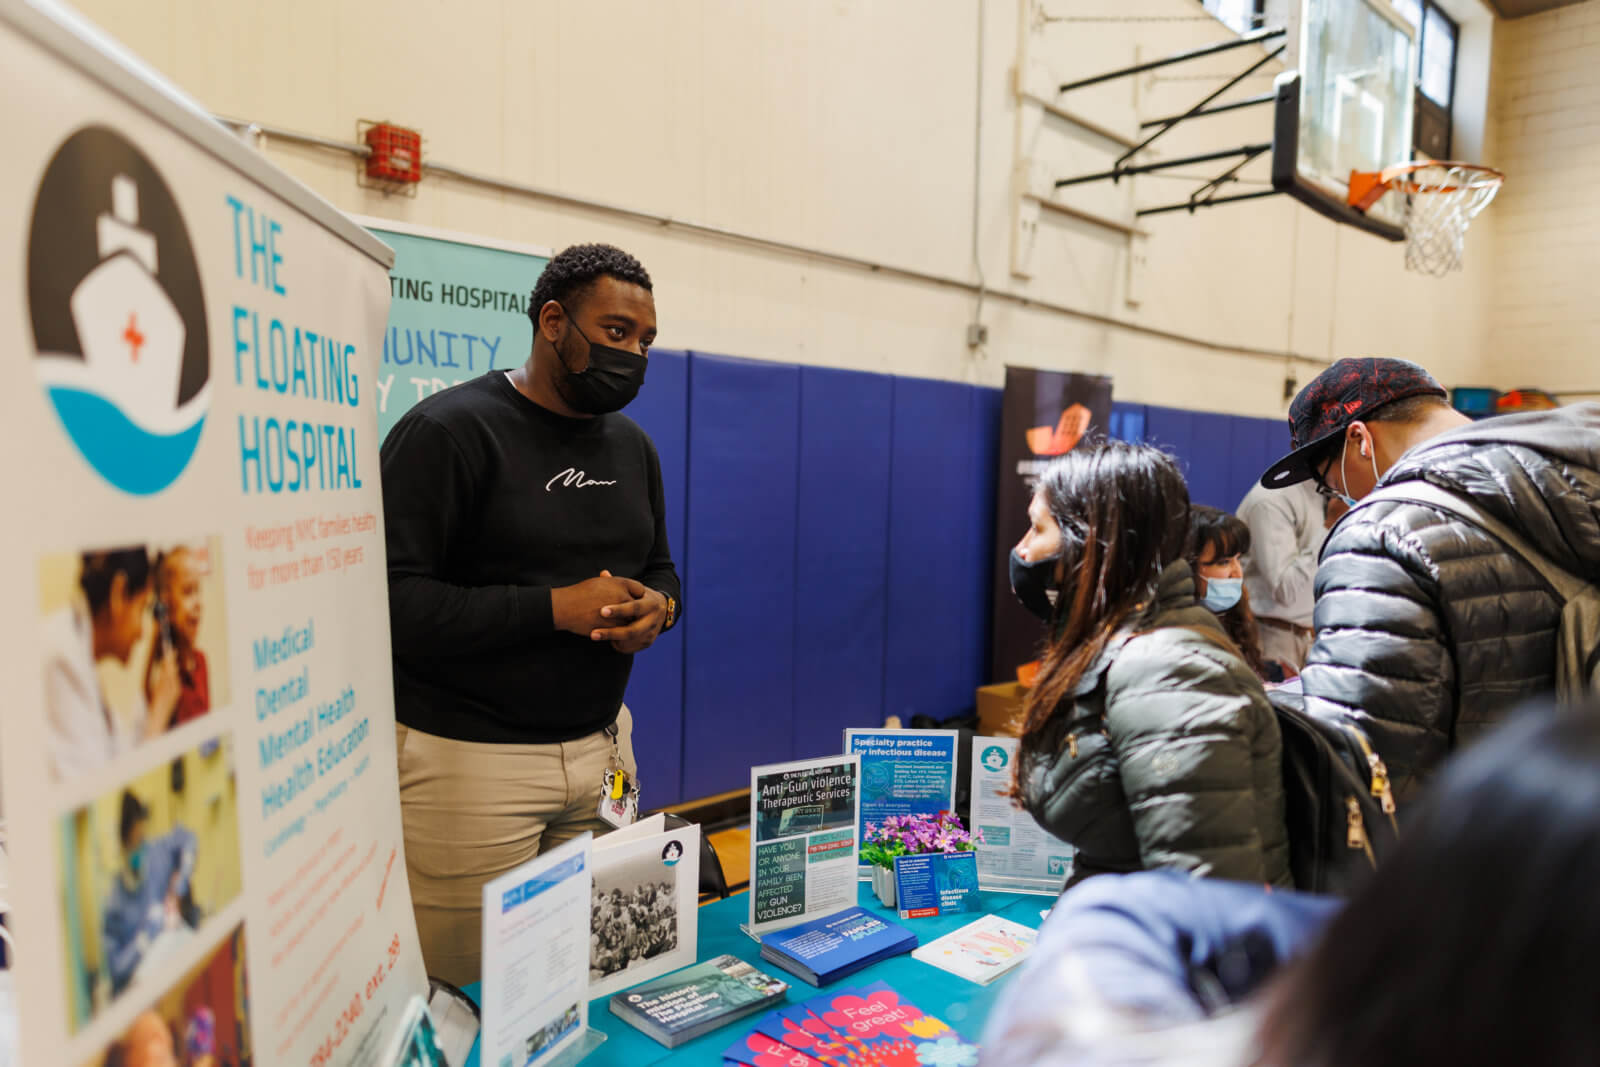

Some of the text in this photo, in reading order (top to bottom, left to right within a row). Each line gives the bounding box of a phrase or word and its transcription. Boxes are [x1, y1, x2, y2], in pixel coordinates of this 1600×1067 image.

[226, 194, 286, 296] THE
[441, 283, 529, 315] HOSPITAL
[233, 306, 359, 407] FLOATING
[237, 414, 362, 494] HOSPITAL
[245, 525, 294, 552] Keeping
[295, 517, 317, 541] NYC
[247, 562, 265, 590] for
[271, 559, 300, 584] more
[301, 552, 323, 576] than
[343, 545, 364, 576] years
[253, 617, 314, 671] Medical
[256, 665, 309, 722] Dental
[258, 708, 314, 770] Mental
[317, 684, 356, 734] Health
[854, 738, 933, 747] Specialty practice
[854, 748, 947, 757] for infectious disease
[262, 755, 315, 820] Health
[317, 717, 369, 776] Education
[762, 775, 851, 796] Anti-Gun violence
[763, 788, 850, 808] Therapeutic Services
[759, 841, 795, 856] HAVE YOU
[759, 852, 800, 866] OR ANYONE
[759, 864, 790, 878] IN YOUR
[759, 872, 803, 888] FAMILY BEEN
[758, 885, 793, 898] AFFECTED
[758, 895, 788, 910] BY GUN
[757, 903, 802, 920] VIOLENCE?
[636, 985, 700, 1009] The historic
[645, 997, 687, 1015] mission
[687, 991, 699, 1000] of
[651, 1008, 675, 1019] The
[674, 992, 719, 1010] Floating
[843, 1000, 889, 1019] Feel
[852, 1008, 909, 1032] great!
